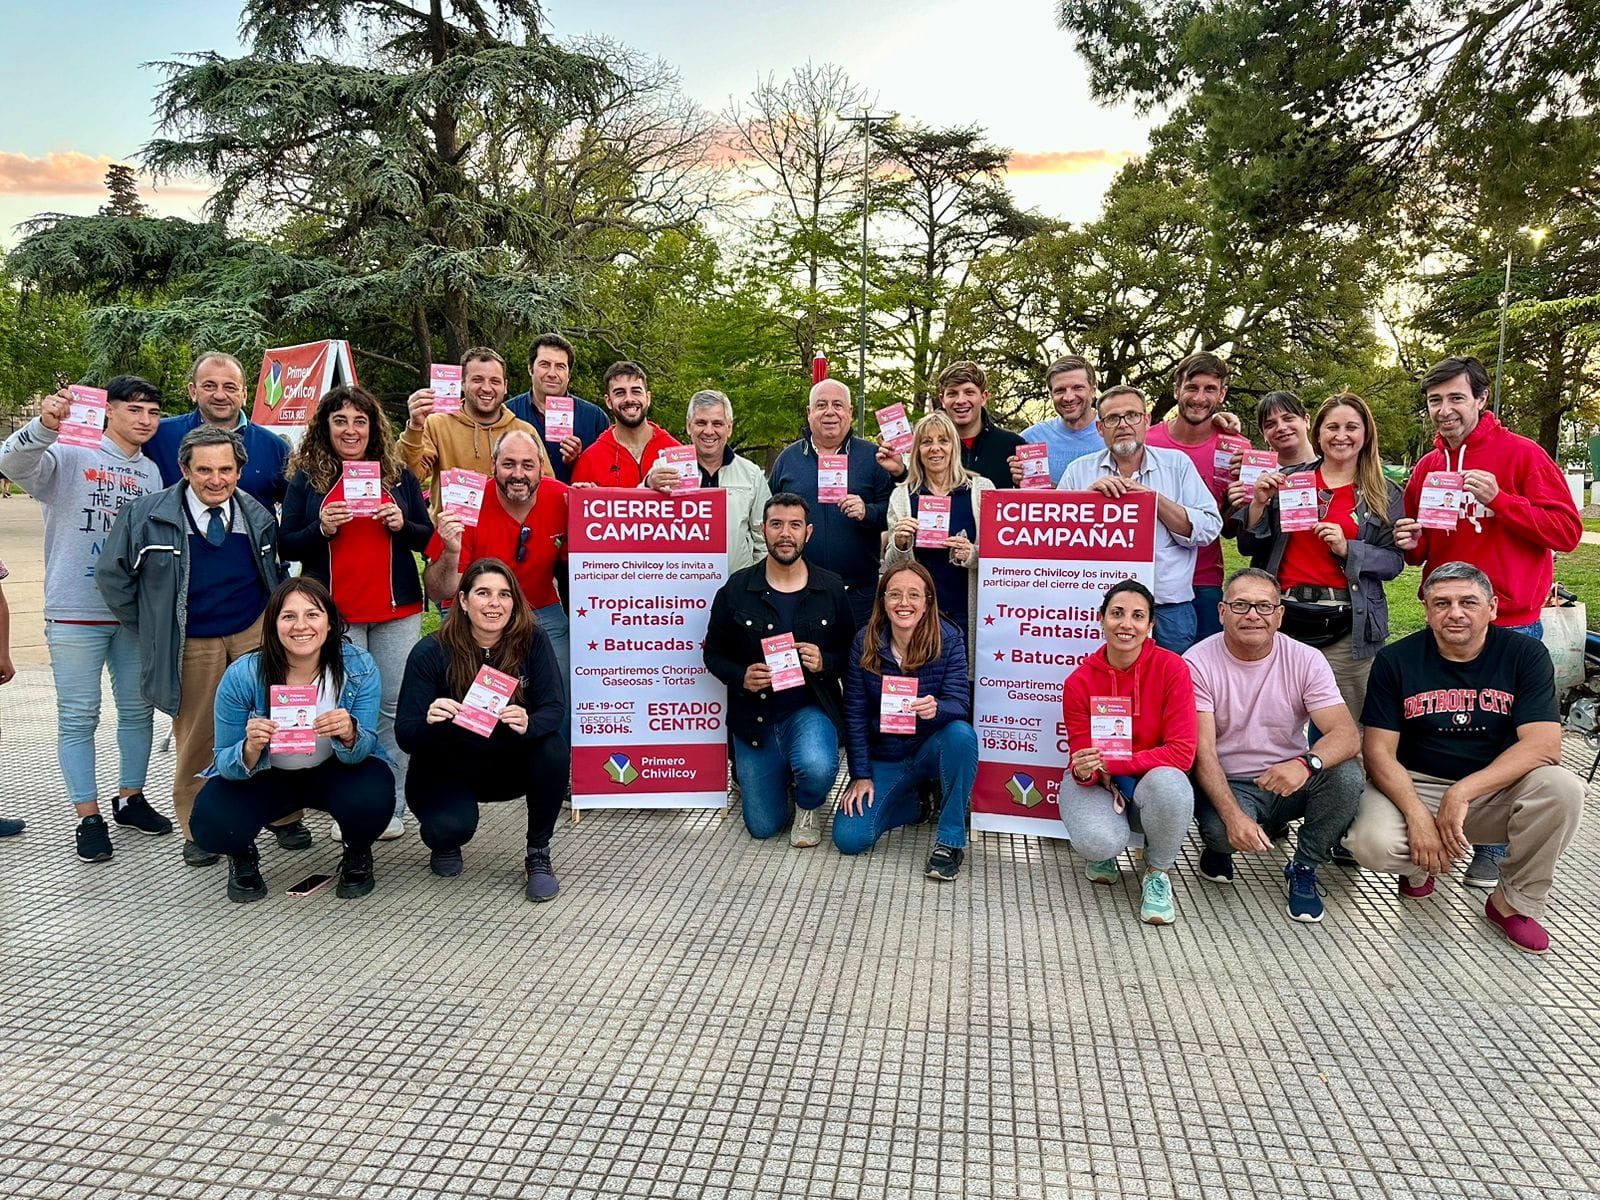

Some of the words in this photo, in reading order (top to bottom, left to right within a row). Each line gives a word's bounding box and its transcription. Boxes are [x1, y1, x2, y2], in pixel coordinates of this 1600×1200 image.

[280, 410, 294, 419] LISTA
[88, 492, 112, 507] THE
[583, 499, 675, 519] ¡CIERRE
[681, 500, 713, 519] DE
[995, 502, 1096, 523] ¡CIERRE
[1103, 503, 1139, 523] DE
[585, 518, 710, 541] CAMPAÑA!
[997, 523, 1135, 548] CAMPAÑA!
[582, 560, 619, 569] Primero
[621, 560, 664, 570] Chivilcoy
[666, 560, 679, 569] los
[681, 561, 706, 569] invita
[574, 571, 619, 580] participar
[621, 571, 636, 580] del
[637, 571, 664, 580] cierre
[665, 571, 677, 580] de
[679, 571, 722, 581] campaña
[992, 567, 1031, 577] Primero
[1033, 568, 1080, 579] Chivilcoy
[1082, 568, 1098, 578] los
[1100, 569, 1128, 579] invita
[983, 578, 1030, 588] participar
[1032, 579, 1048, 588] del
[1050, 580, 1079, 589] cierre
[1081, 581, 1095, 590] de
[587, 596, 707, 612] Tropicalisimo
[611, 612, 684, 626] Fantasía
[1019, 622, 1100, 640] Fantasía
[604, 638, 694, 651] Batucadas
[575, 666, 659, 677] Compartiremos
[602, 677, 653, 686] Gaseosas
[663, 676, 696, 686] Tortas
[1007, 690, 1063, 703] Gaseosas
[647, 702, 722, 716] ESTADIO
[1404, 688, 1477, 719] DETROIT
[580, 716, 611, 724] DESDE
[613, 715, 632, 723] LAS
[648, 717, 721, 731] CENTRO
[579, 724, 633, 734] 19:30Hs.
[983, 729, 1016, 739] DESDE
[1018, 732, 1038, 741] LAS
[982, 737, 1038, 753] 19:30Hs.
[641, 757, 685, 766] Primero
[641, 768, 697, 780] Chivilcoy
